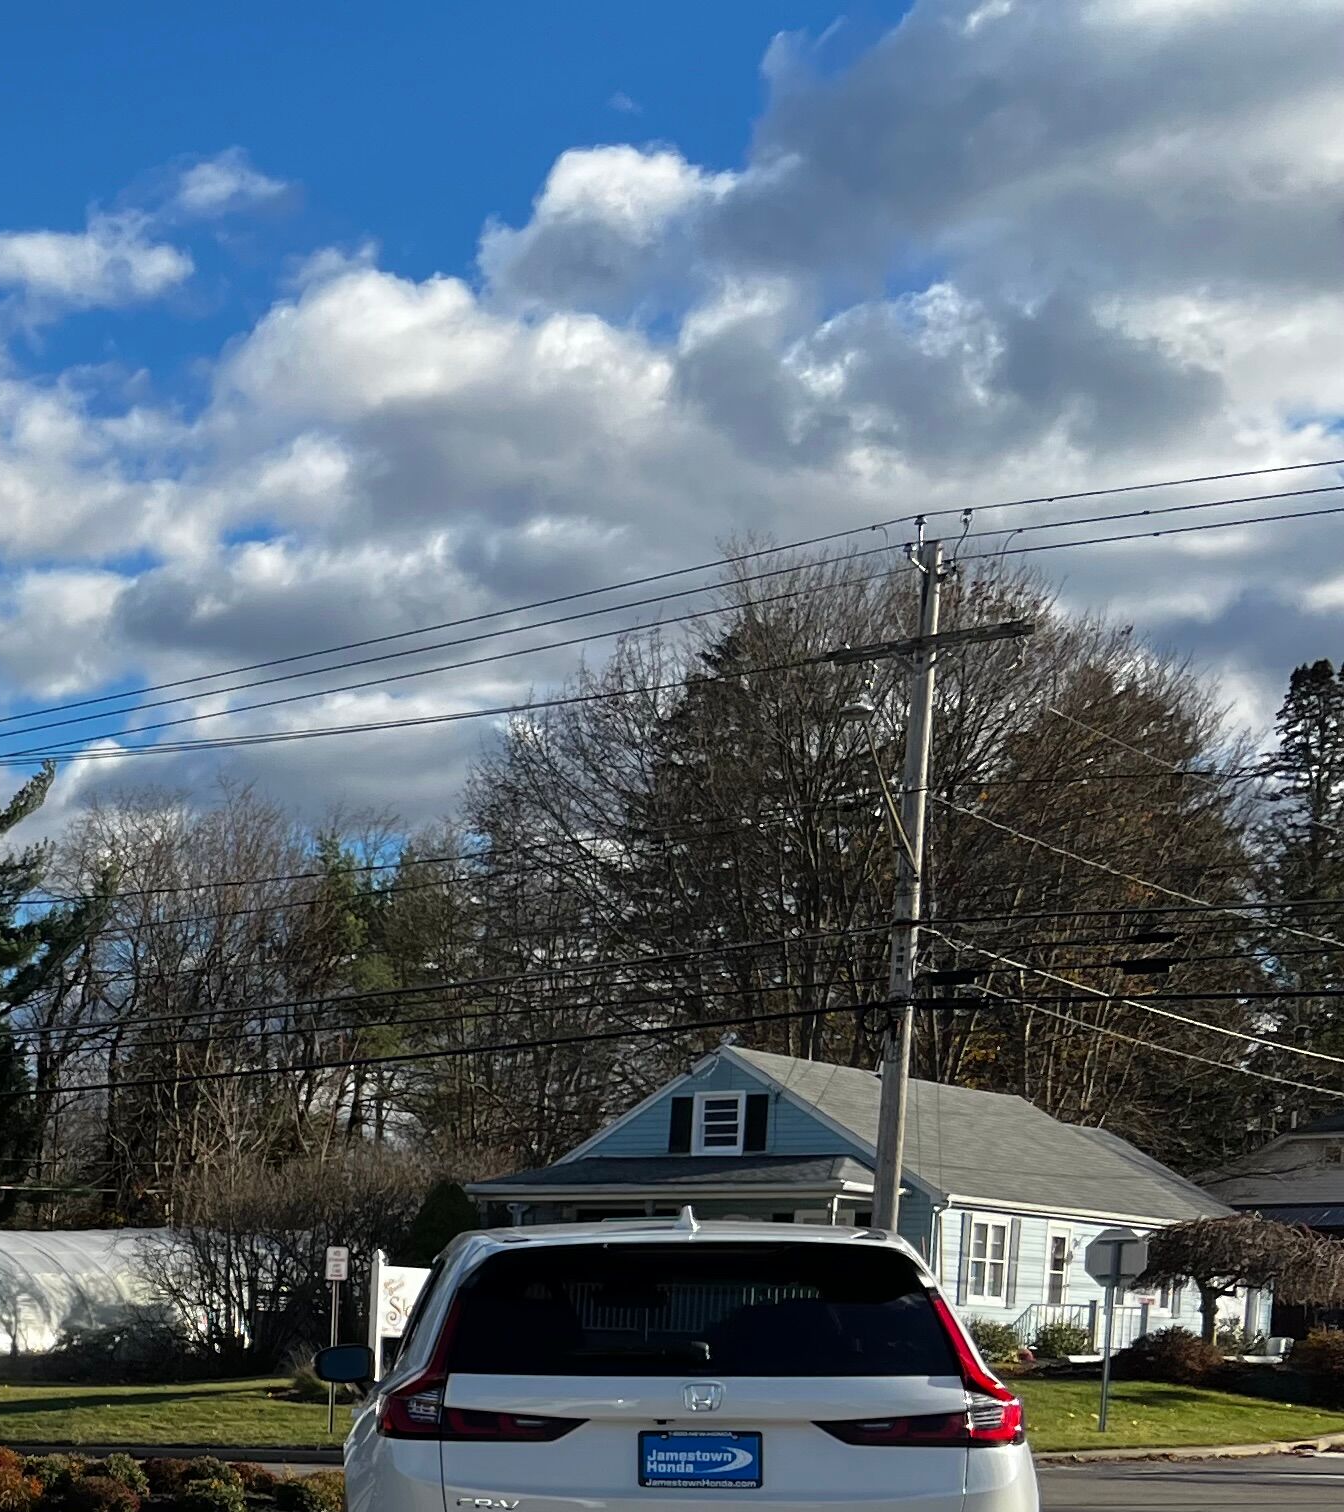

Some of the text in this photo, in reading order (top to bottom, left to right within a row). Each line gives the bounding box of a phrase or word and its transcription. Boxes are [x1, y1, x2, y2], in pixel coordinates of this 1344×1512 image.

[647, 1449, 732, 1462] Jamestown
[646, 1461, 694, 1473] Honda
[645, 1478, 757, 1488] JamestownHonda.com
